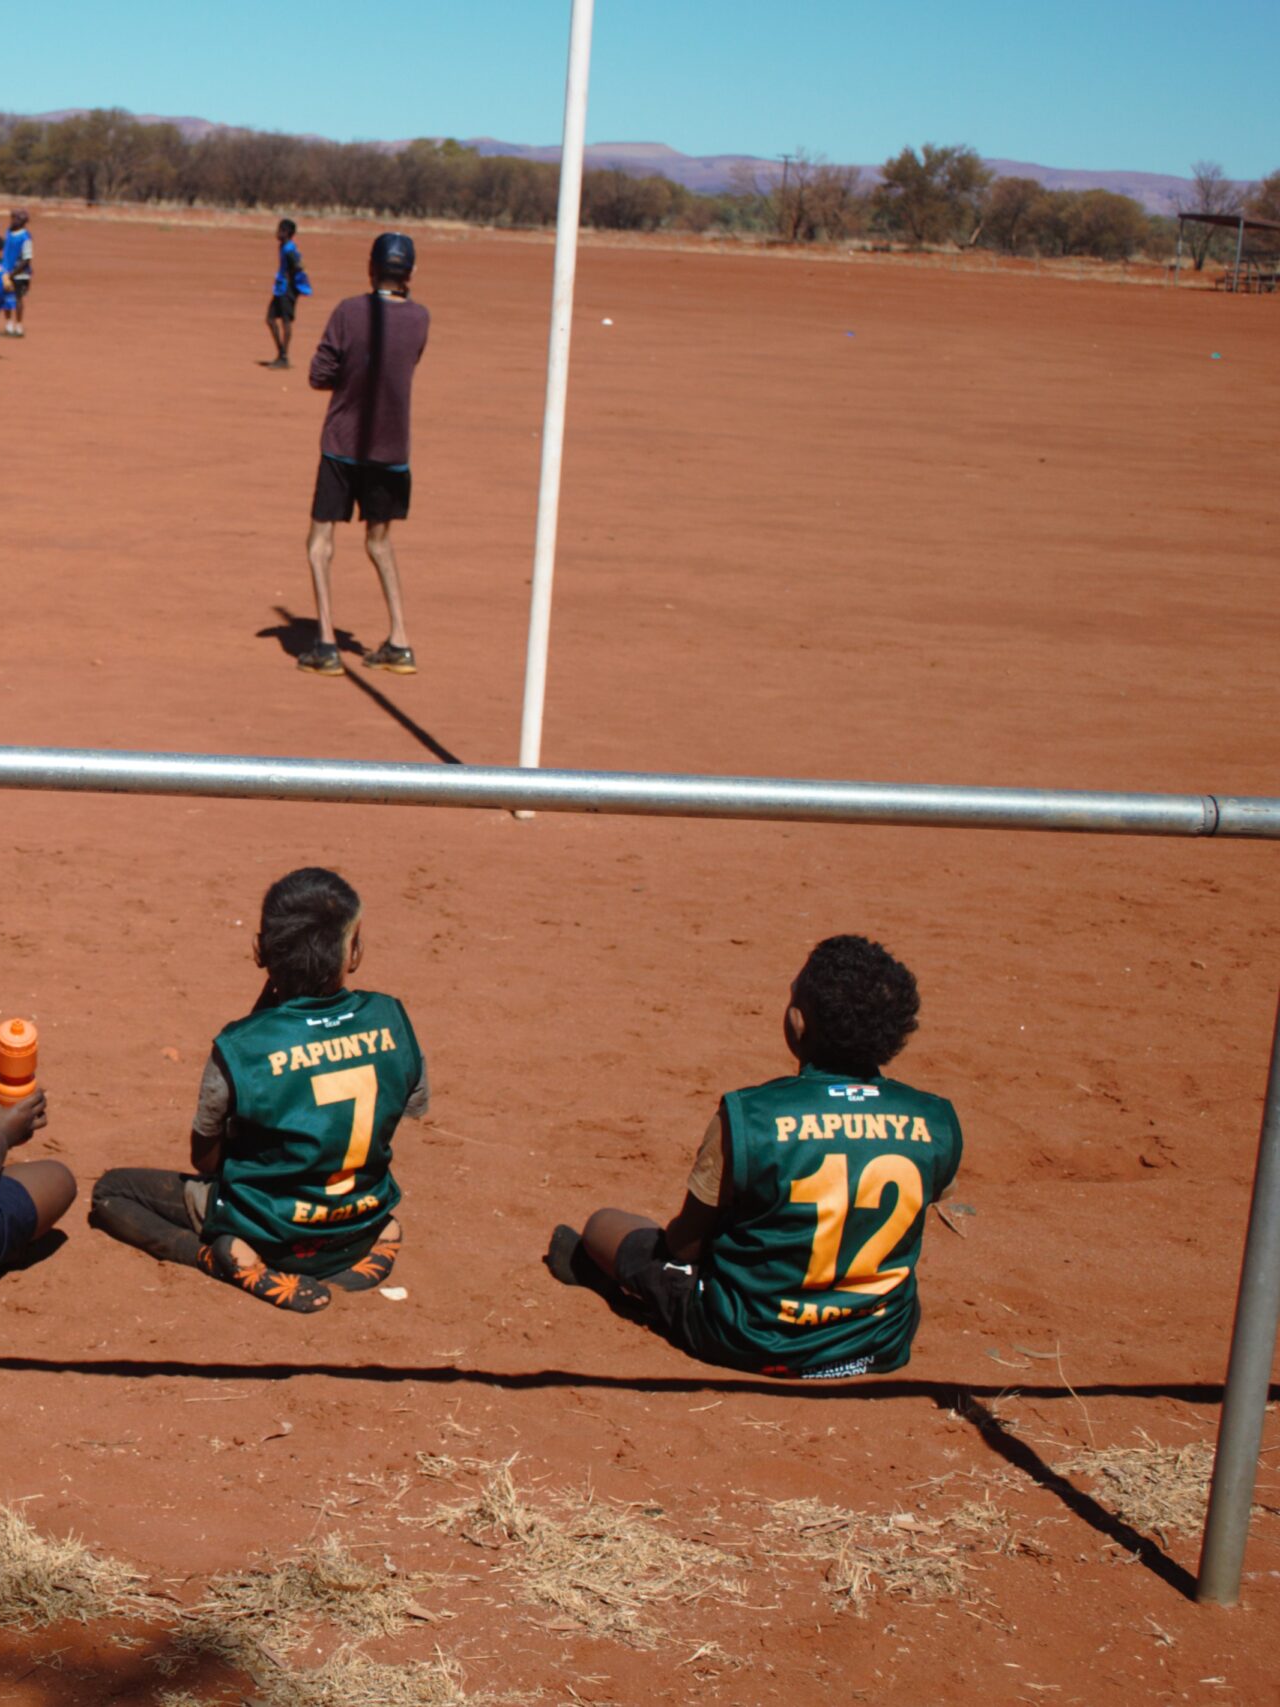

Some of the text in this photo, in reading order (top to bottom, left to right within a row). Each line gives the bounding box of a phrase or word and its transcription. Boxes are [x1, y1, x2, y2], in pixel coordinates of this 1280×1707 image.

[268, 1028, 397, 1076] PAPUNYA
[310, 1064, 379, 1195] 7
[775, 1114, 932, 1143] PAPUNYA
[789, 1153, 924, 1296] 12
